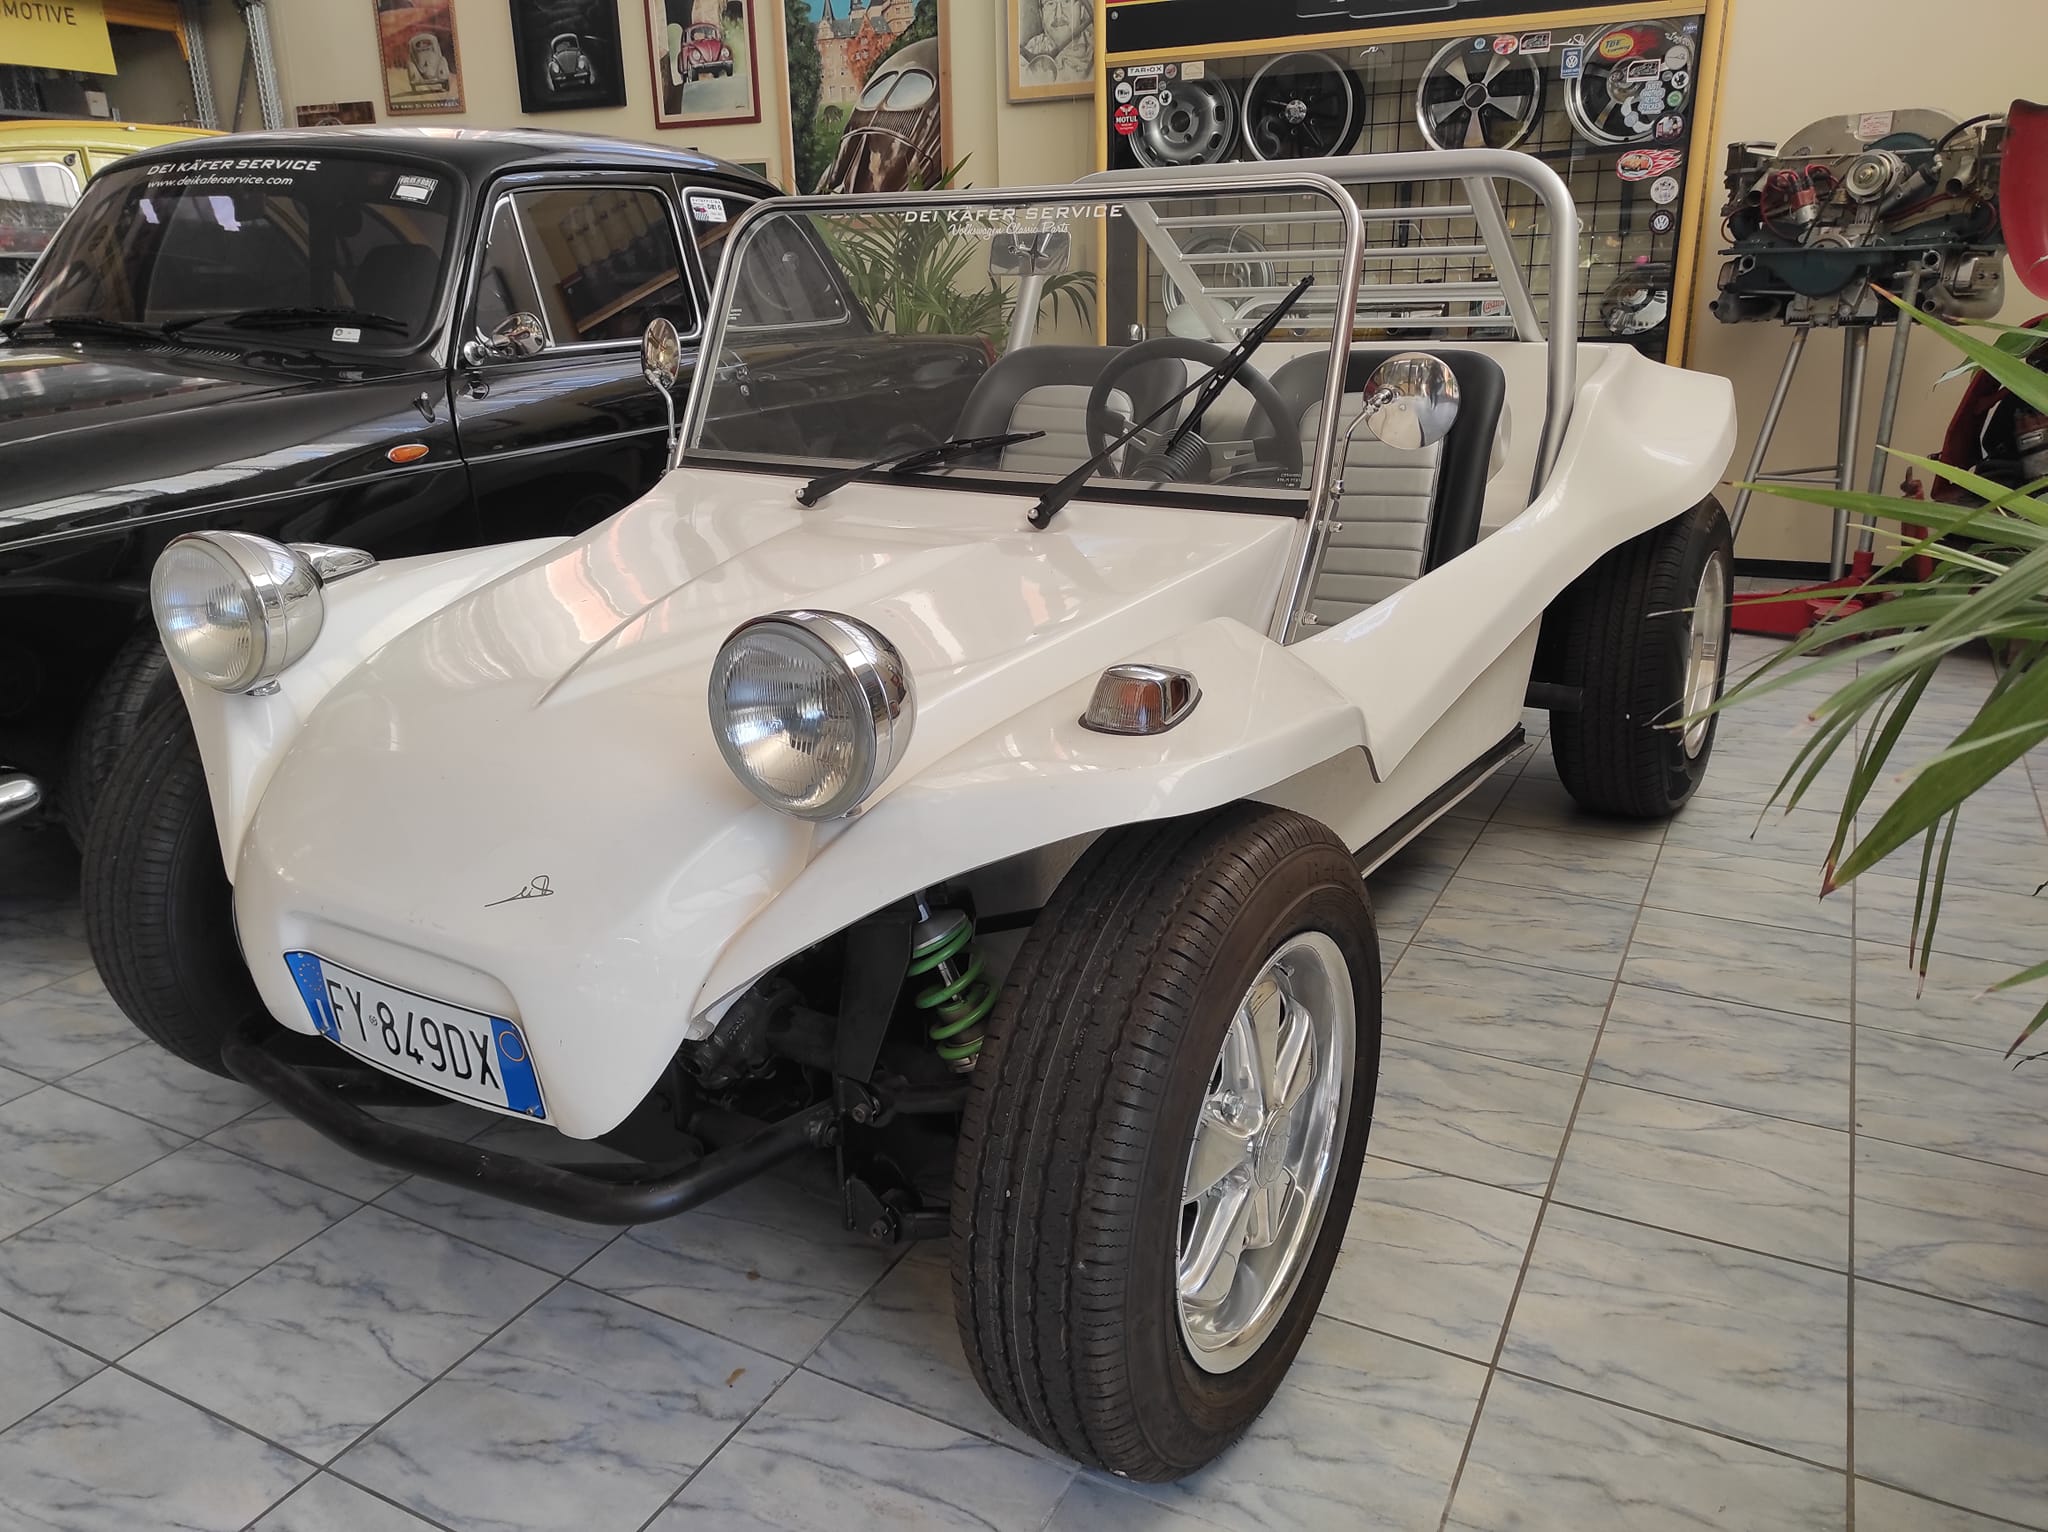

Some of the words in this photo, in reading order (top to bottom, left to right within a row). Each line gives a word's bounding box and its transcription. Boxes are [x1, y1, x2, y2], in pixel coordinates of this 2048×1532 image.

[0, 0, 77, 26] MOTIVE
[1115, 115, 1137, 123] MOTUL
[147, 163, 177, 176] DEI
[177, 159, 233, 172] KÄFER
[235, 159, 321, 171] SERVICE
[905, 210, 938, 223] DEI
[946, 205, 1016, 222] KÄFER
[1025, 204, 1125, 220] SERVICE
[948, 223, 1002, 240] Volkswagen
